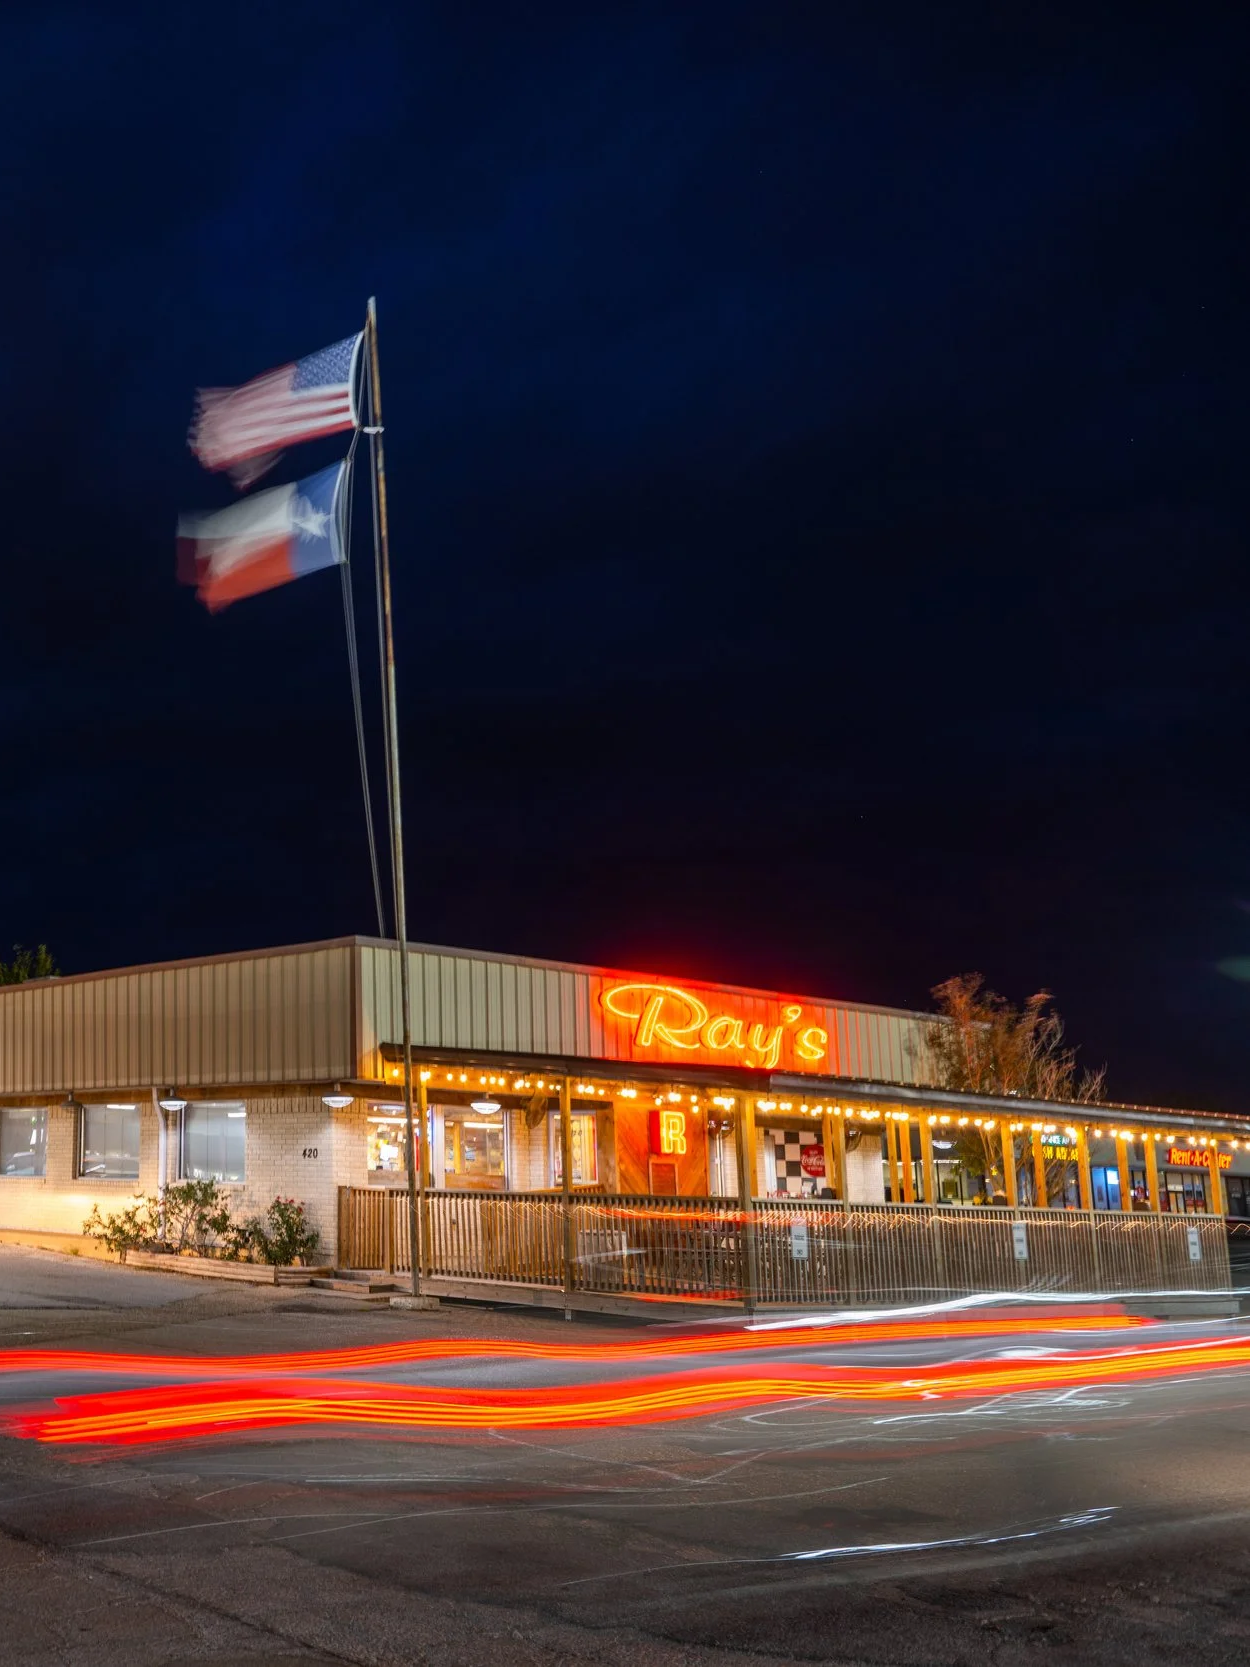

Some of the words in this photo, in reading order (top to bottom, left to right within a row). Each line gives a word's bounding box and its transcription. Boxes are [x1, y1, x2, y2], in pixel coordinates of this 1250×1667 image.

[605, 984, 828, 1069] Ray's
[302, 1147, 318, 1160] 420
[660, 1110, 687, 1154] R
